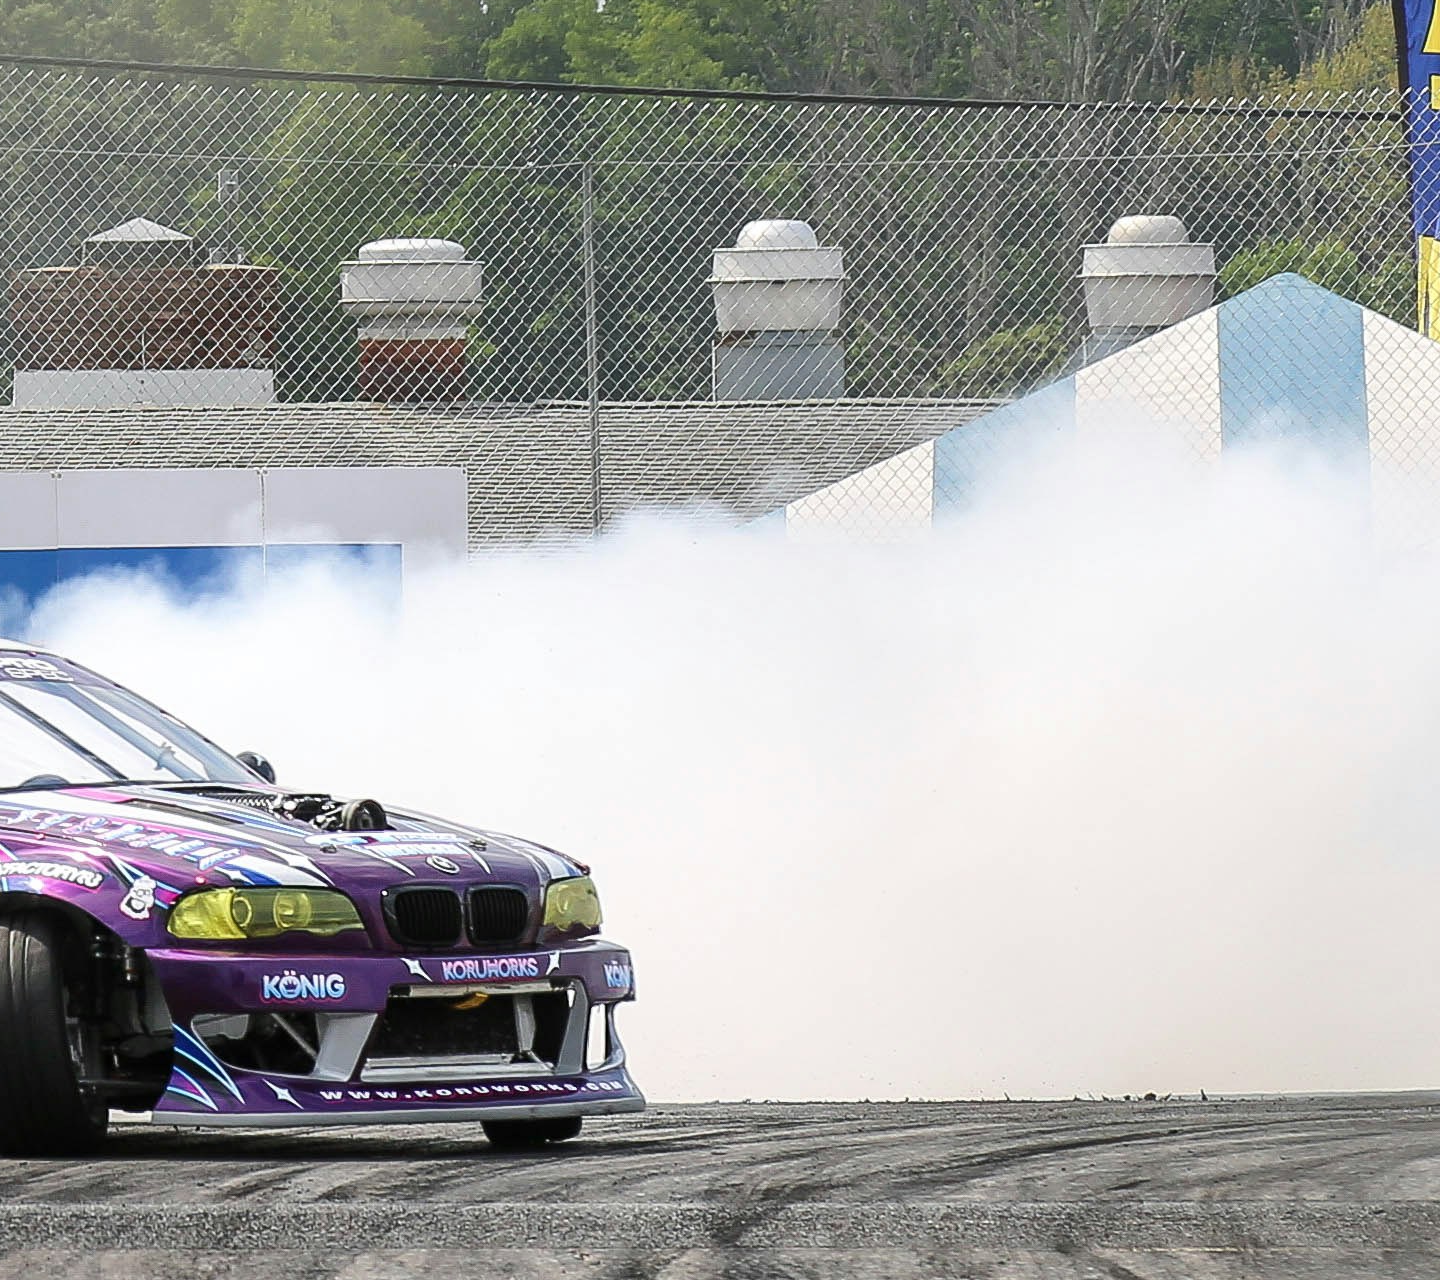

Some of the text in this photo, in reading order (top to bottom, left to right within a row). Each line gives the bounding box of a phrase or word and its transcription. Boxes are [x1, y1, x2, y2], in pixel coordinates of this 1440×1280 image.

[5, 667, 74, 682] SPEC
[441, 956, 539, 981] KORUWORKS
[262, 969, 347, 1001] KÖNIG
